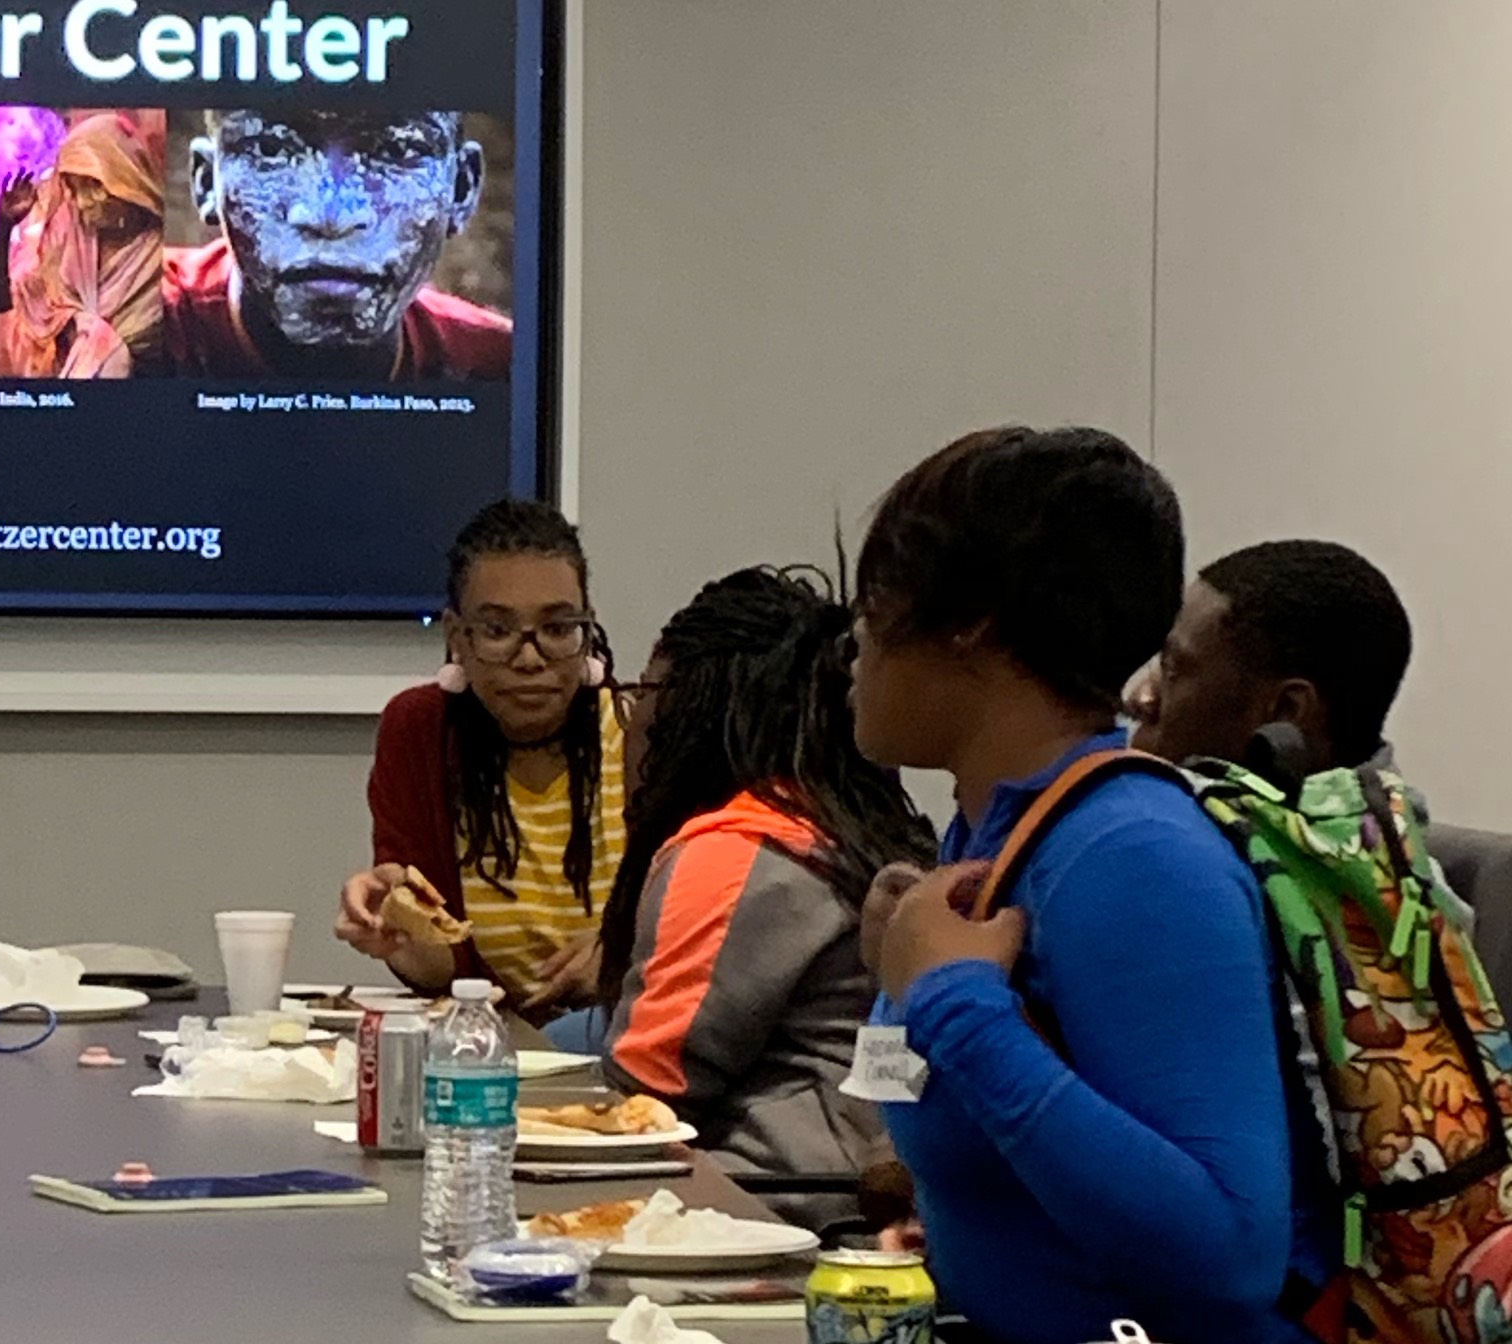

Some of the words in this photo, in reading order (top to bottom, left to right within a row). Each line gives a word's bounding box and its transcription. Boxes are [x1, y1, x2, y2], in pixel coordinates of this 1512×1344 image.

[239, 393, 256, 411] by
[258, 394, 293, 412] Larry
[295, 394, 309, 409] C.
